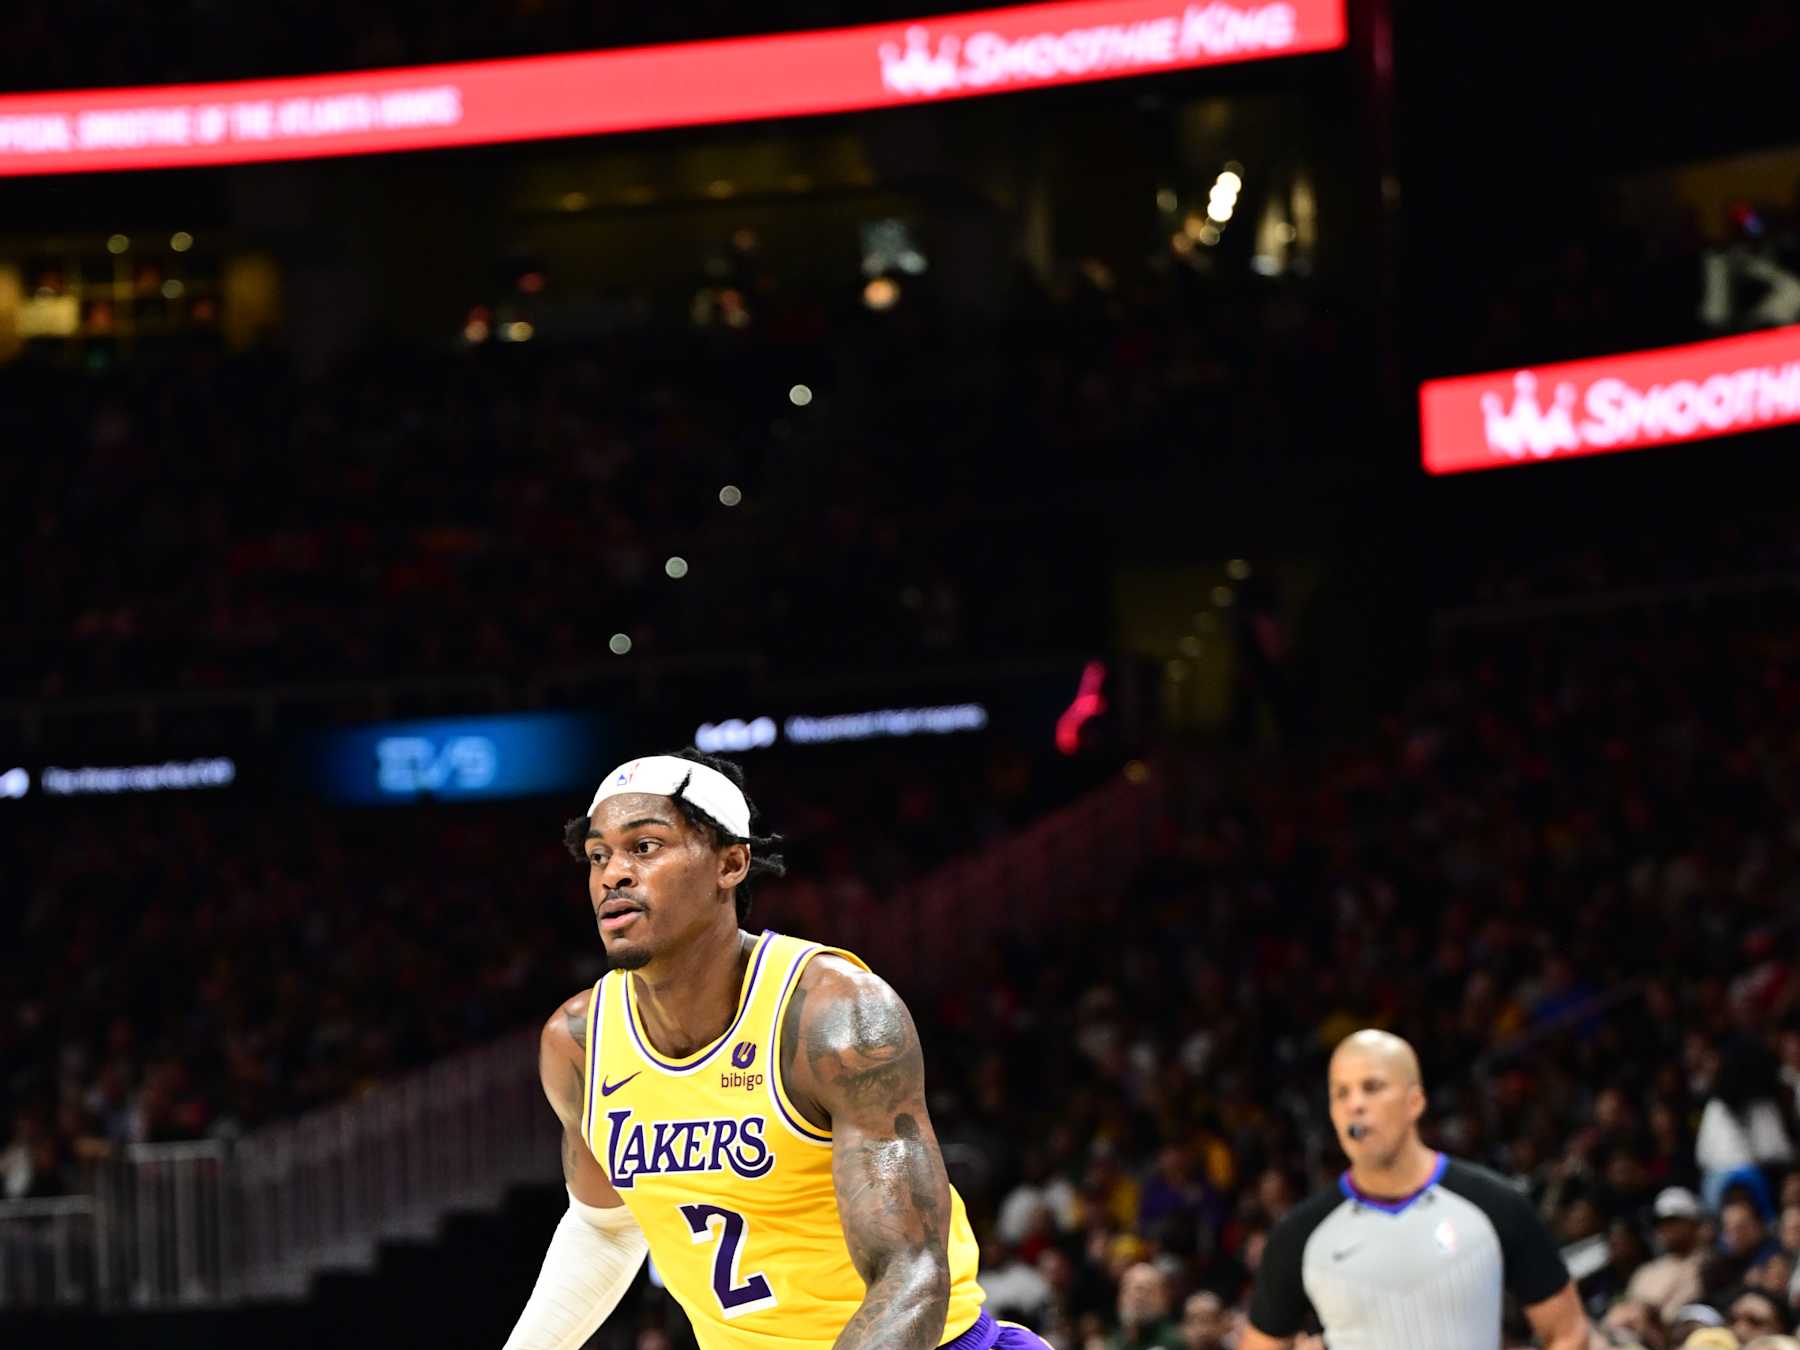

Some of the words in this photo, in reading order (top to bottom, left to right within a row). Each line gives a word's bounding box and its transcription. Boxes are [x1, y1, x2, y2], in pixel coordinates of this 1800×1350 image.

[720, 1072, 764, 1091] bibigo
[606, 1107, 775, 1189] LAKERS
[676, 1202, 779, 1320] 2
